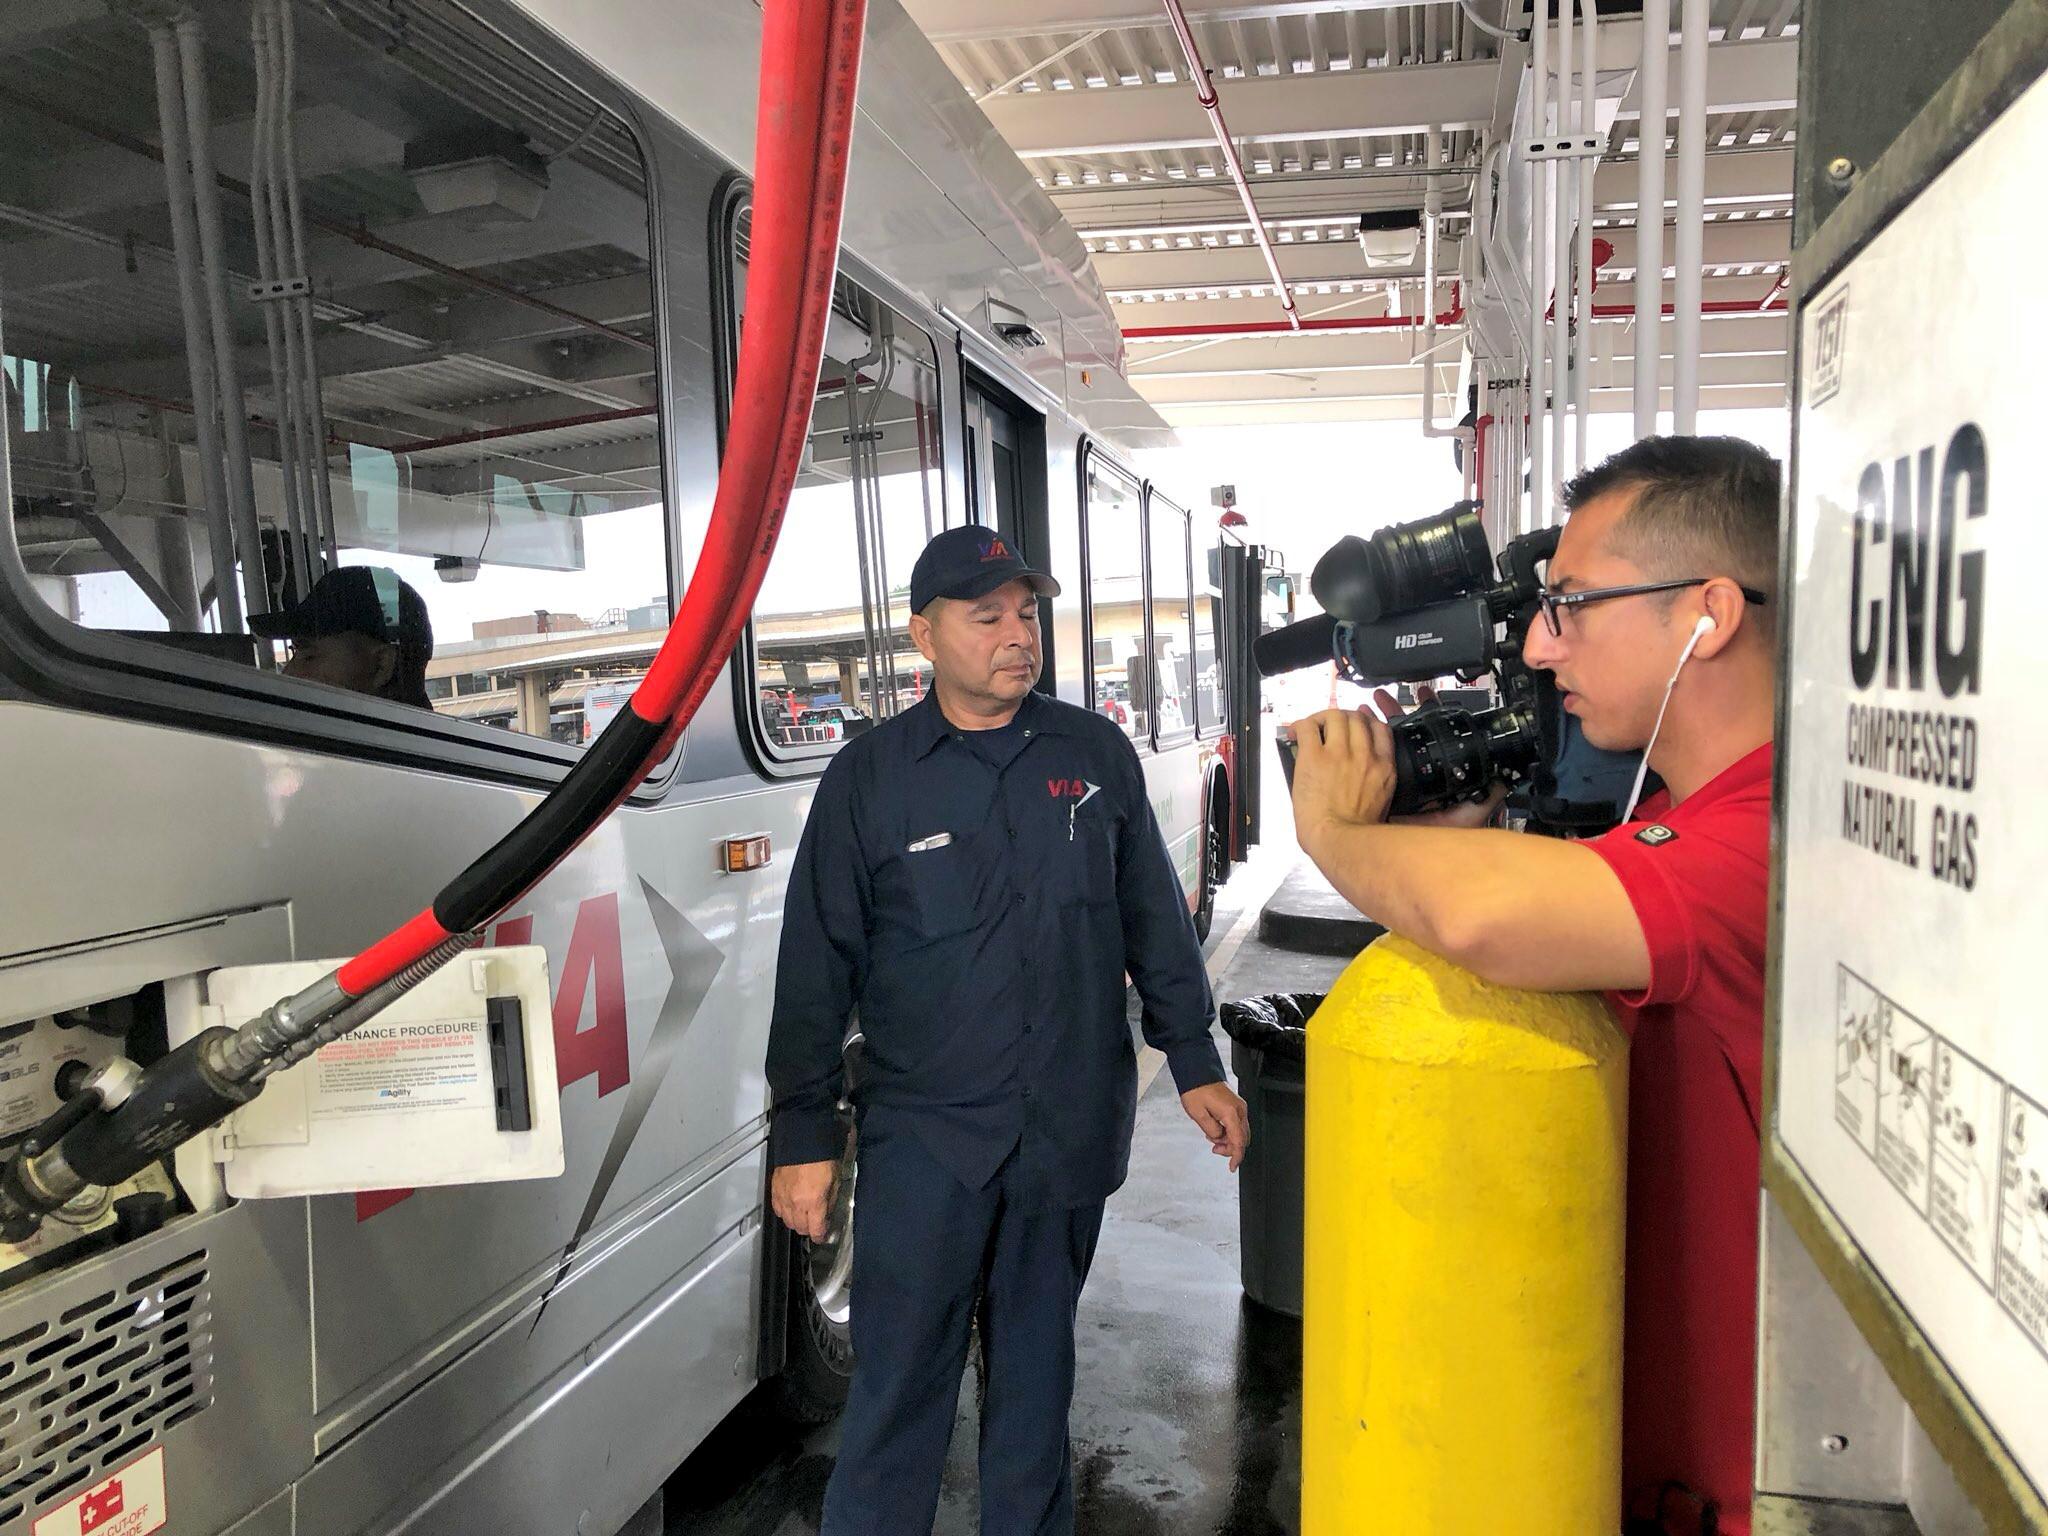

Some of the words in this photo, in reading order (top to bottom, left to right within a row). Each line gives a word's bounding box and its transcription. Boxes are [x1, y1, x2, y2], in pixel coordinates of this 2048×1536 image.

[978, 539, 1008, 556] VIA
[1849, 421, 1989, 699] CNG
[1395, 634, 1417, 649] HD
[1848, 702, 1978, 793] COMPRESSED
[1047, 777, 1085, 798] VIA
[1842, 780, 1919, 869] NATURAL
[1931, 803, 1979, 893] GAS
[400, 1022, 482, 1037] PROCEDURE:
[387, 1088, 411, 1098] Agility
